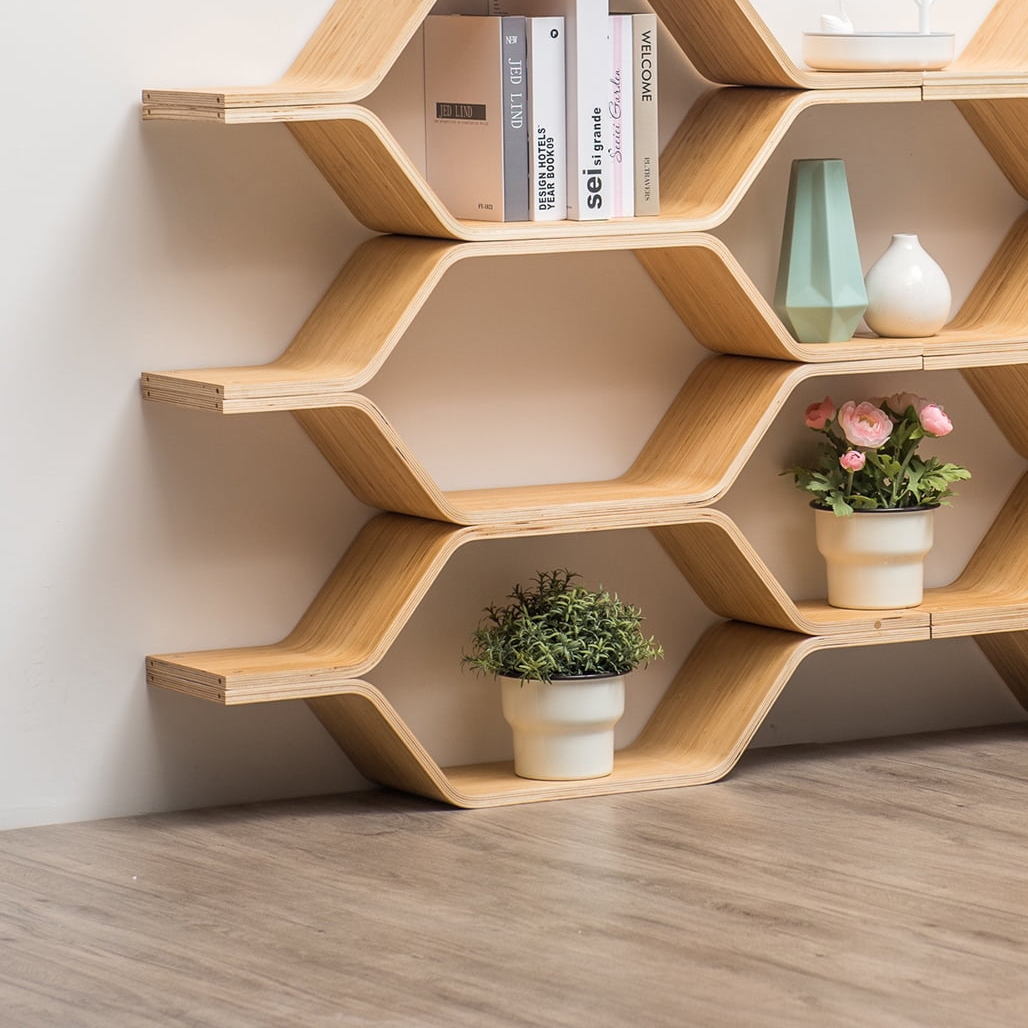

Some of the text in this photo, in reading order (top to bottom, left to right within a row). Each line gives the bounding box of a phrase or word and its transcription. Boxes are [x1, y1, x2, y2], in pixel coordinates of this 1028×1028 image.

[508, 57, 523, 130] JED LIND
[609, 69, 622, 119] Garden
[641, 30, 653, 102] WELCOME
[582, 107, 604, 209] sei si grande
[538, 172, 547, 211] DESIGN
[546, 183, 556, 211] YEAR
